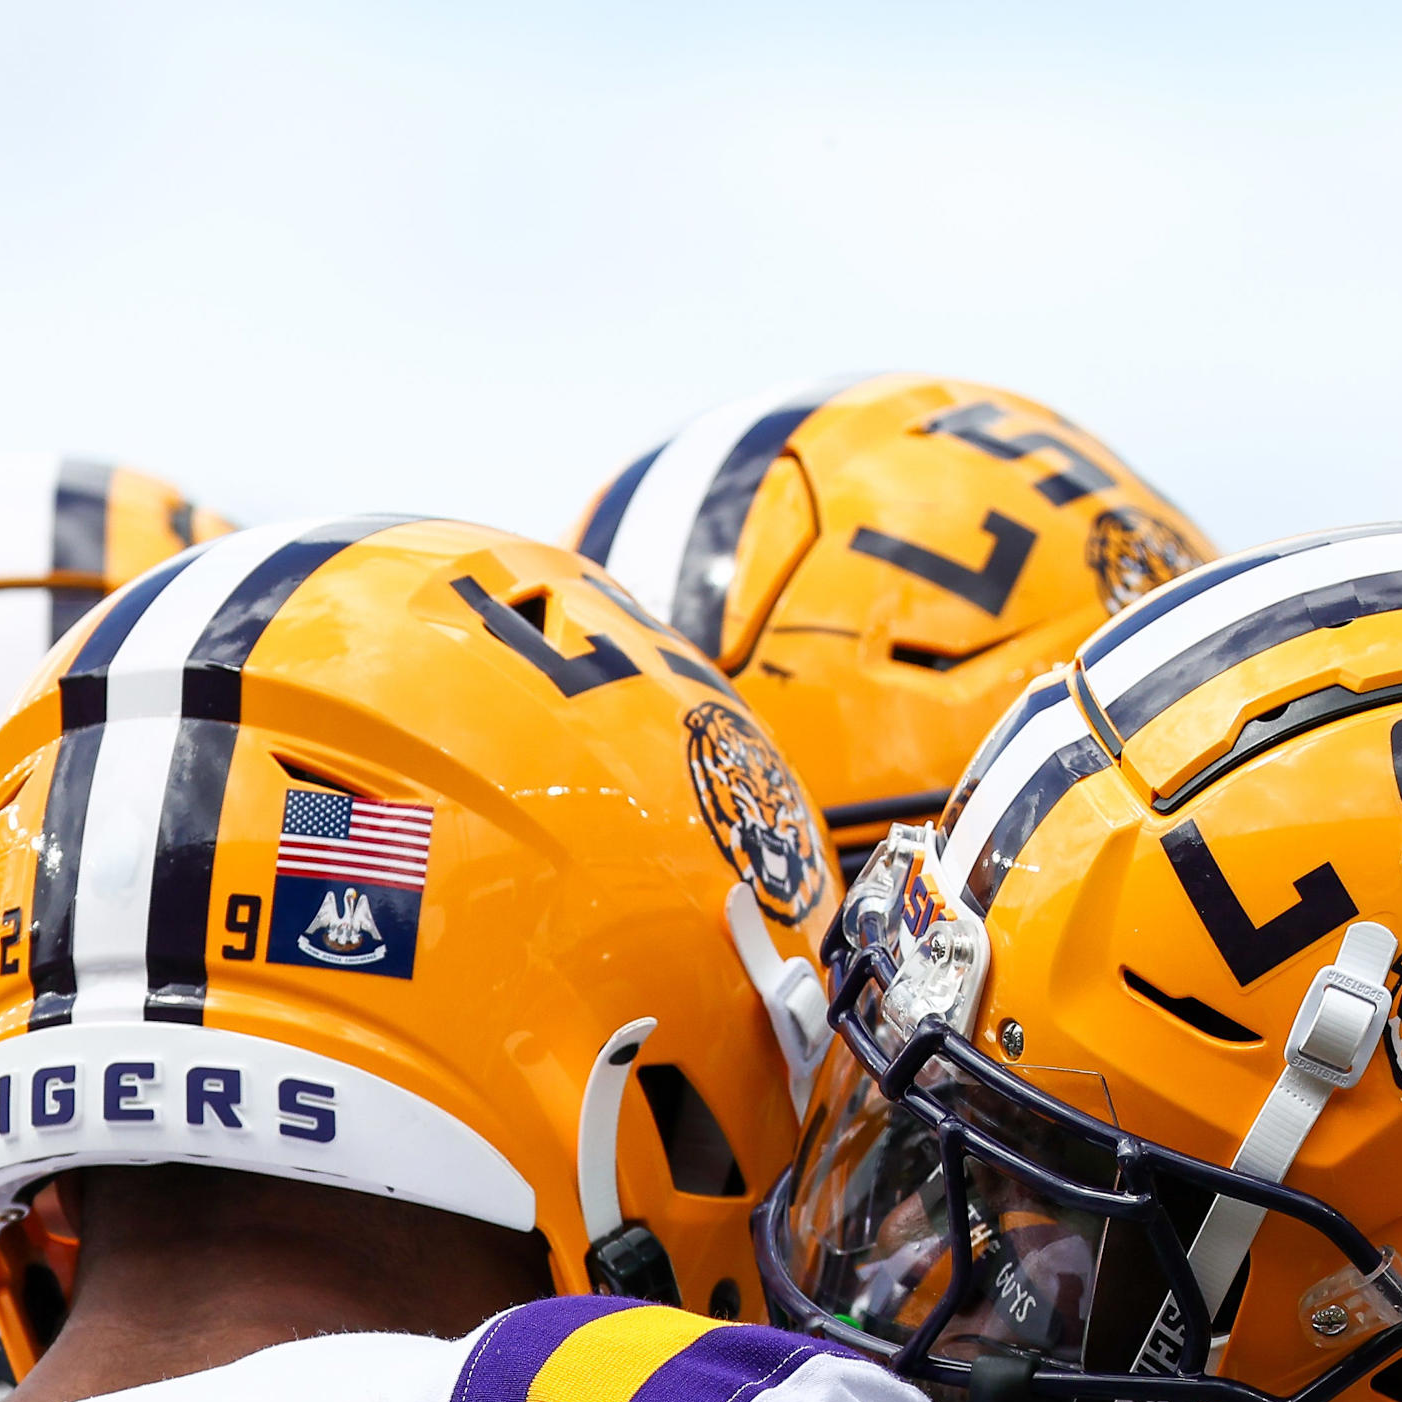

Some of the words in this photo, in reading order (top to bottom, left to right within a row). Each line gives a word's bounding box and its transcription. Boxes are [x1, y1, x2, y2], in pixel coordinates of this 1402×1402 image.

[850, 402, 1118, 618] LS
[0, 906, 21, 977] 2
[222, 893, 262, 961] 9
[1326, 969, 1386, 1002] SPORTSTAR
[1290, 1055, 1350, 1087] SPORTSTAR
[995, 1261, 1037, 1323] GUYS
